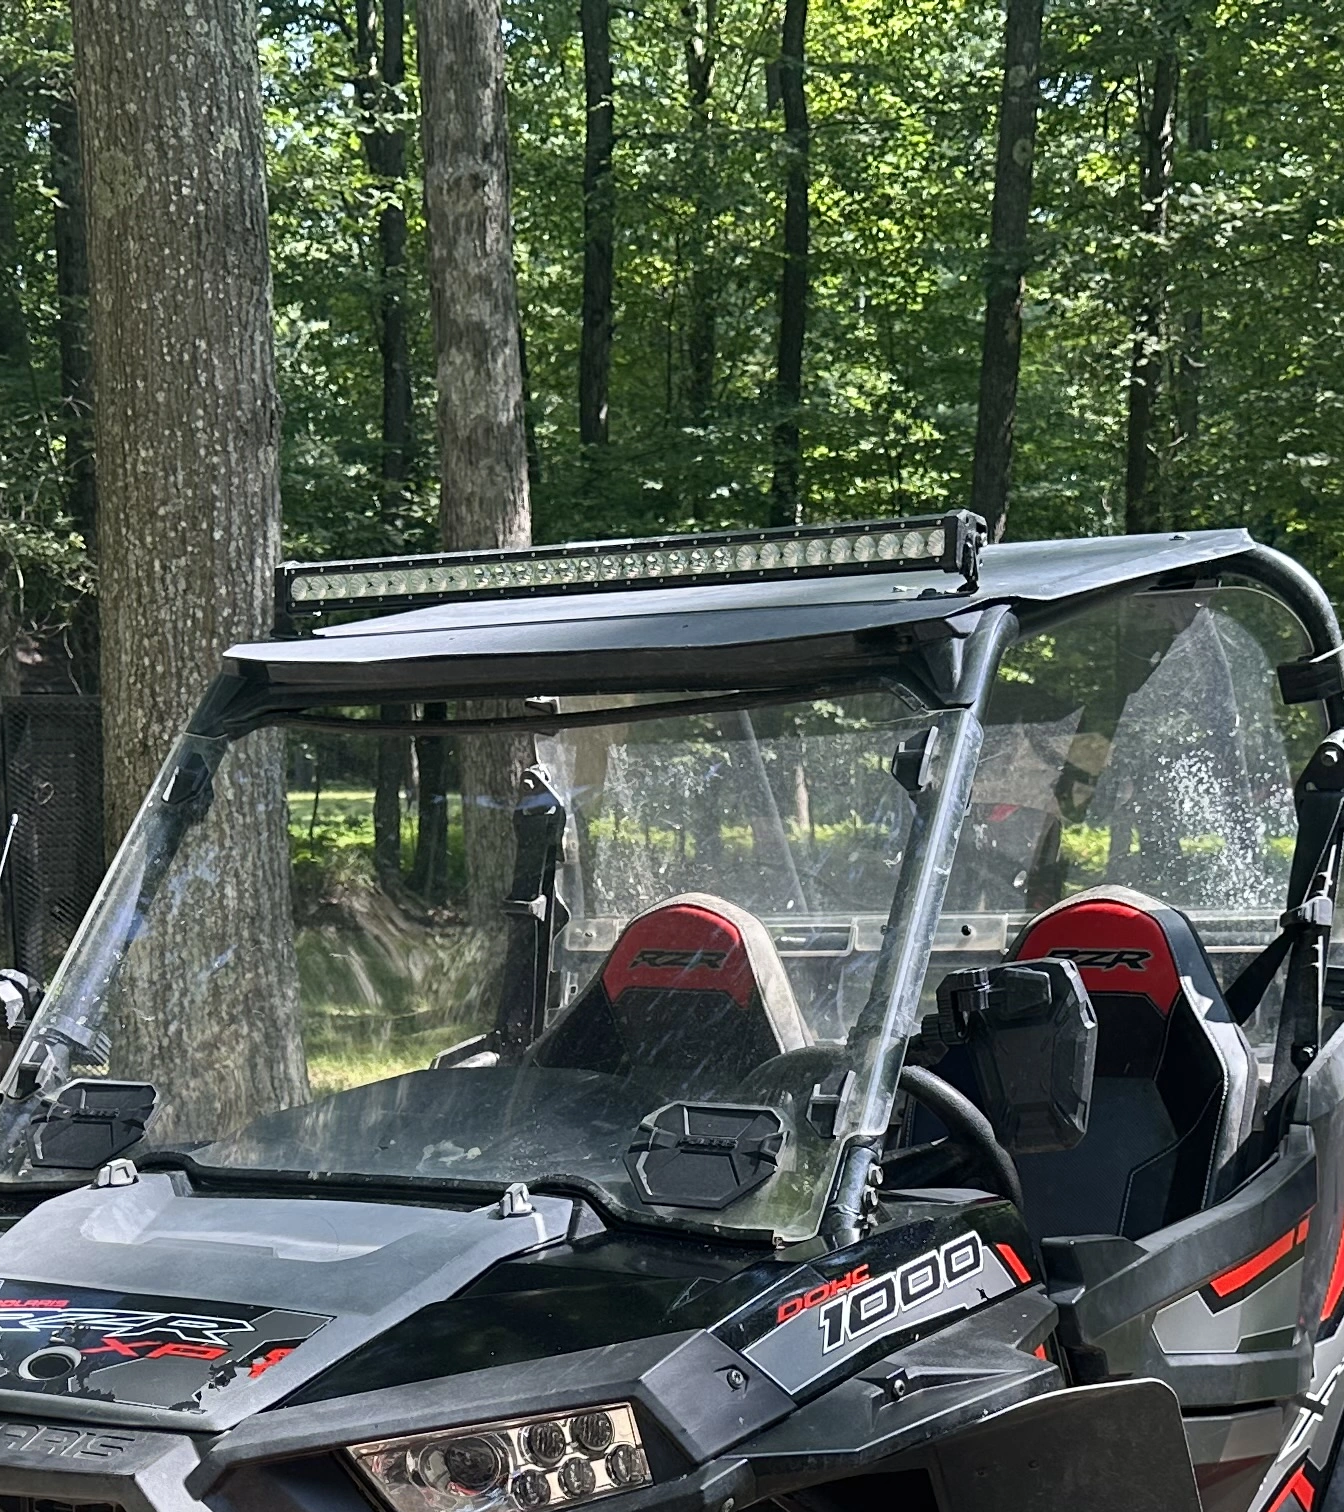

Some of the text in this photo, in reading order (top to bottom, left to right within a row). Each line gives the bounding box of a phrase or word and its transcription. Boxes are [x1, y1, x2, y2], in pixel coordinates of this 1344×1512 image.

[628, 948, 727, 970] RZR
[777, 1264, 872, 1324] DOHC
[818, 1230, 985, 1356] 1000
[81, 1337, 233, 1361] XP
